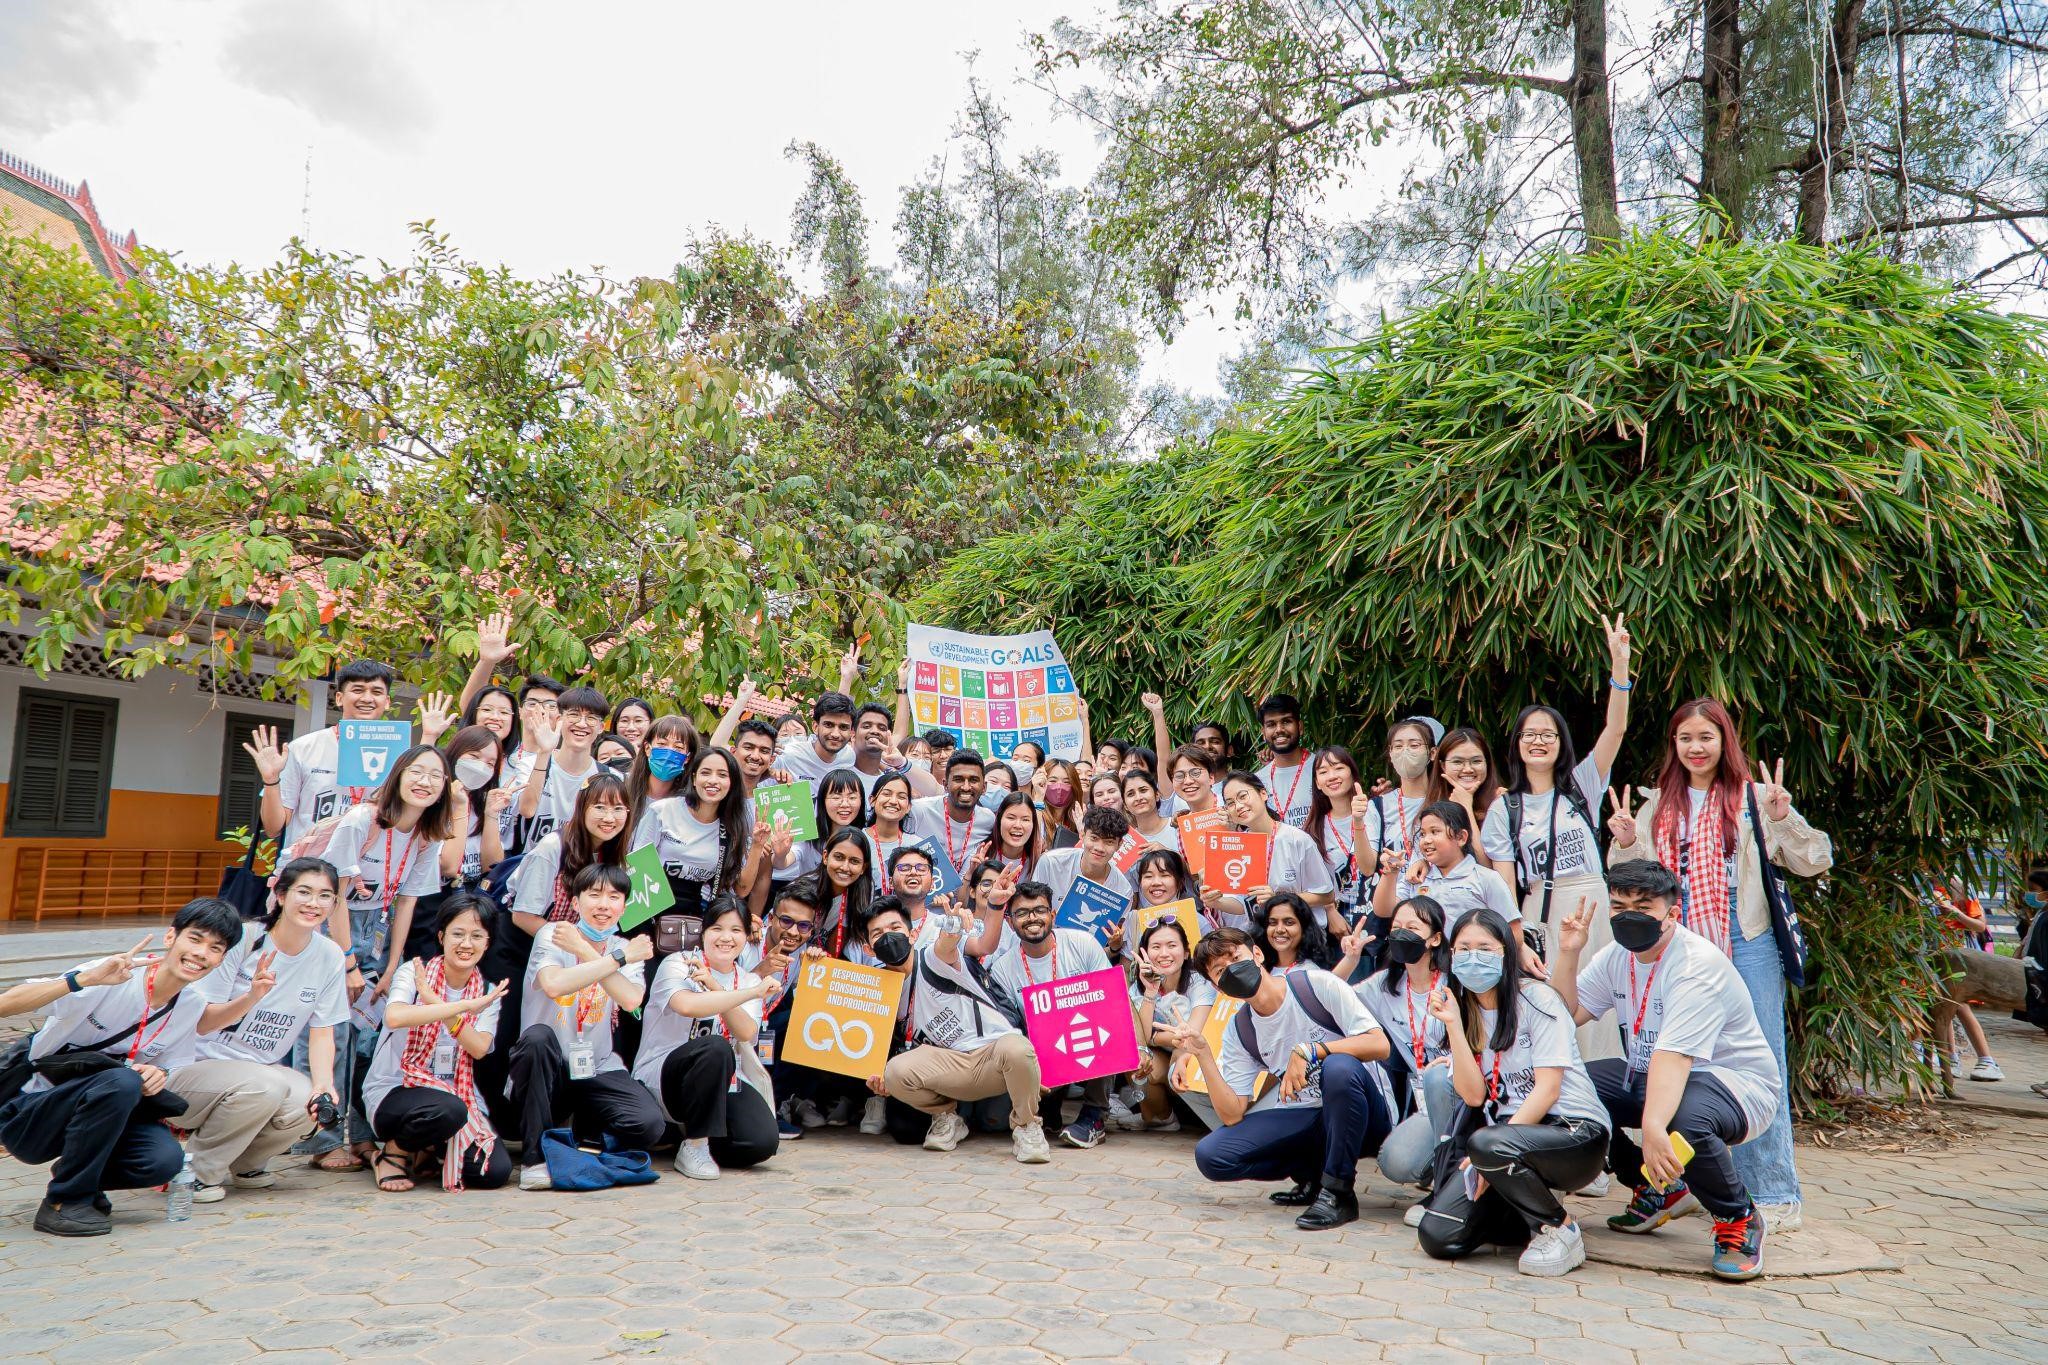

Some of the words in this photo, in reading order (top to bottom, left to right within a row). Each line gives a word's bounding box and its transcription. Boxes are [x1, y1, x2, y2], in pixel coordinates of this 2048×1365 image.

[944, 642, 989, 656] SUSTAINABLE
[991, 643, 1054, 666] GOALS
[944, 652, 989, 665] DEVELOPMENT
[345, 725, 354, 739] 6
[1053, 741, 1079, 750] GOALS
[759, 792, 770, 805] 15
[1183, 819, 1192, 832] 9
[1210, 836, 1218, 849] 5
[1557, 827, 1584, 846] ORLD'S
[1557, 840, 1586, 858] ARGEST
[1075, 881, 1089, 895] 16
[807, 963, 827, 989] 12
[831, 967, 881, 987] RESPONSIBLE
[300, 990, 316, 999] aws
[829, 980, 883, 1001] CONSUMPTION
[1054, 980, 1090, 997] REDUCED
[826, 994, 843, 1006] AND
[842, 997, 890, 1016] PRODUCTION
[1029, 989, 1052, 1015] 10
[1056, 989, 1105, 1010] INEQUALITIES
[254, 1009, 296, 1027] WORLD'S
[925, 1006, 954, 1034] WORLD'S
[246, 1022, 289, 1040] LARGEST
[932, 1015, 961, 1042] LARGEST
[1310, 1028, 1325, 1040] aws
[241, 1033, 278, 1052] LESSON
